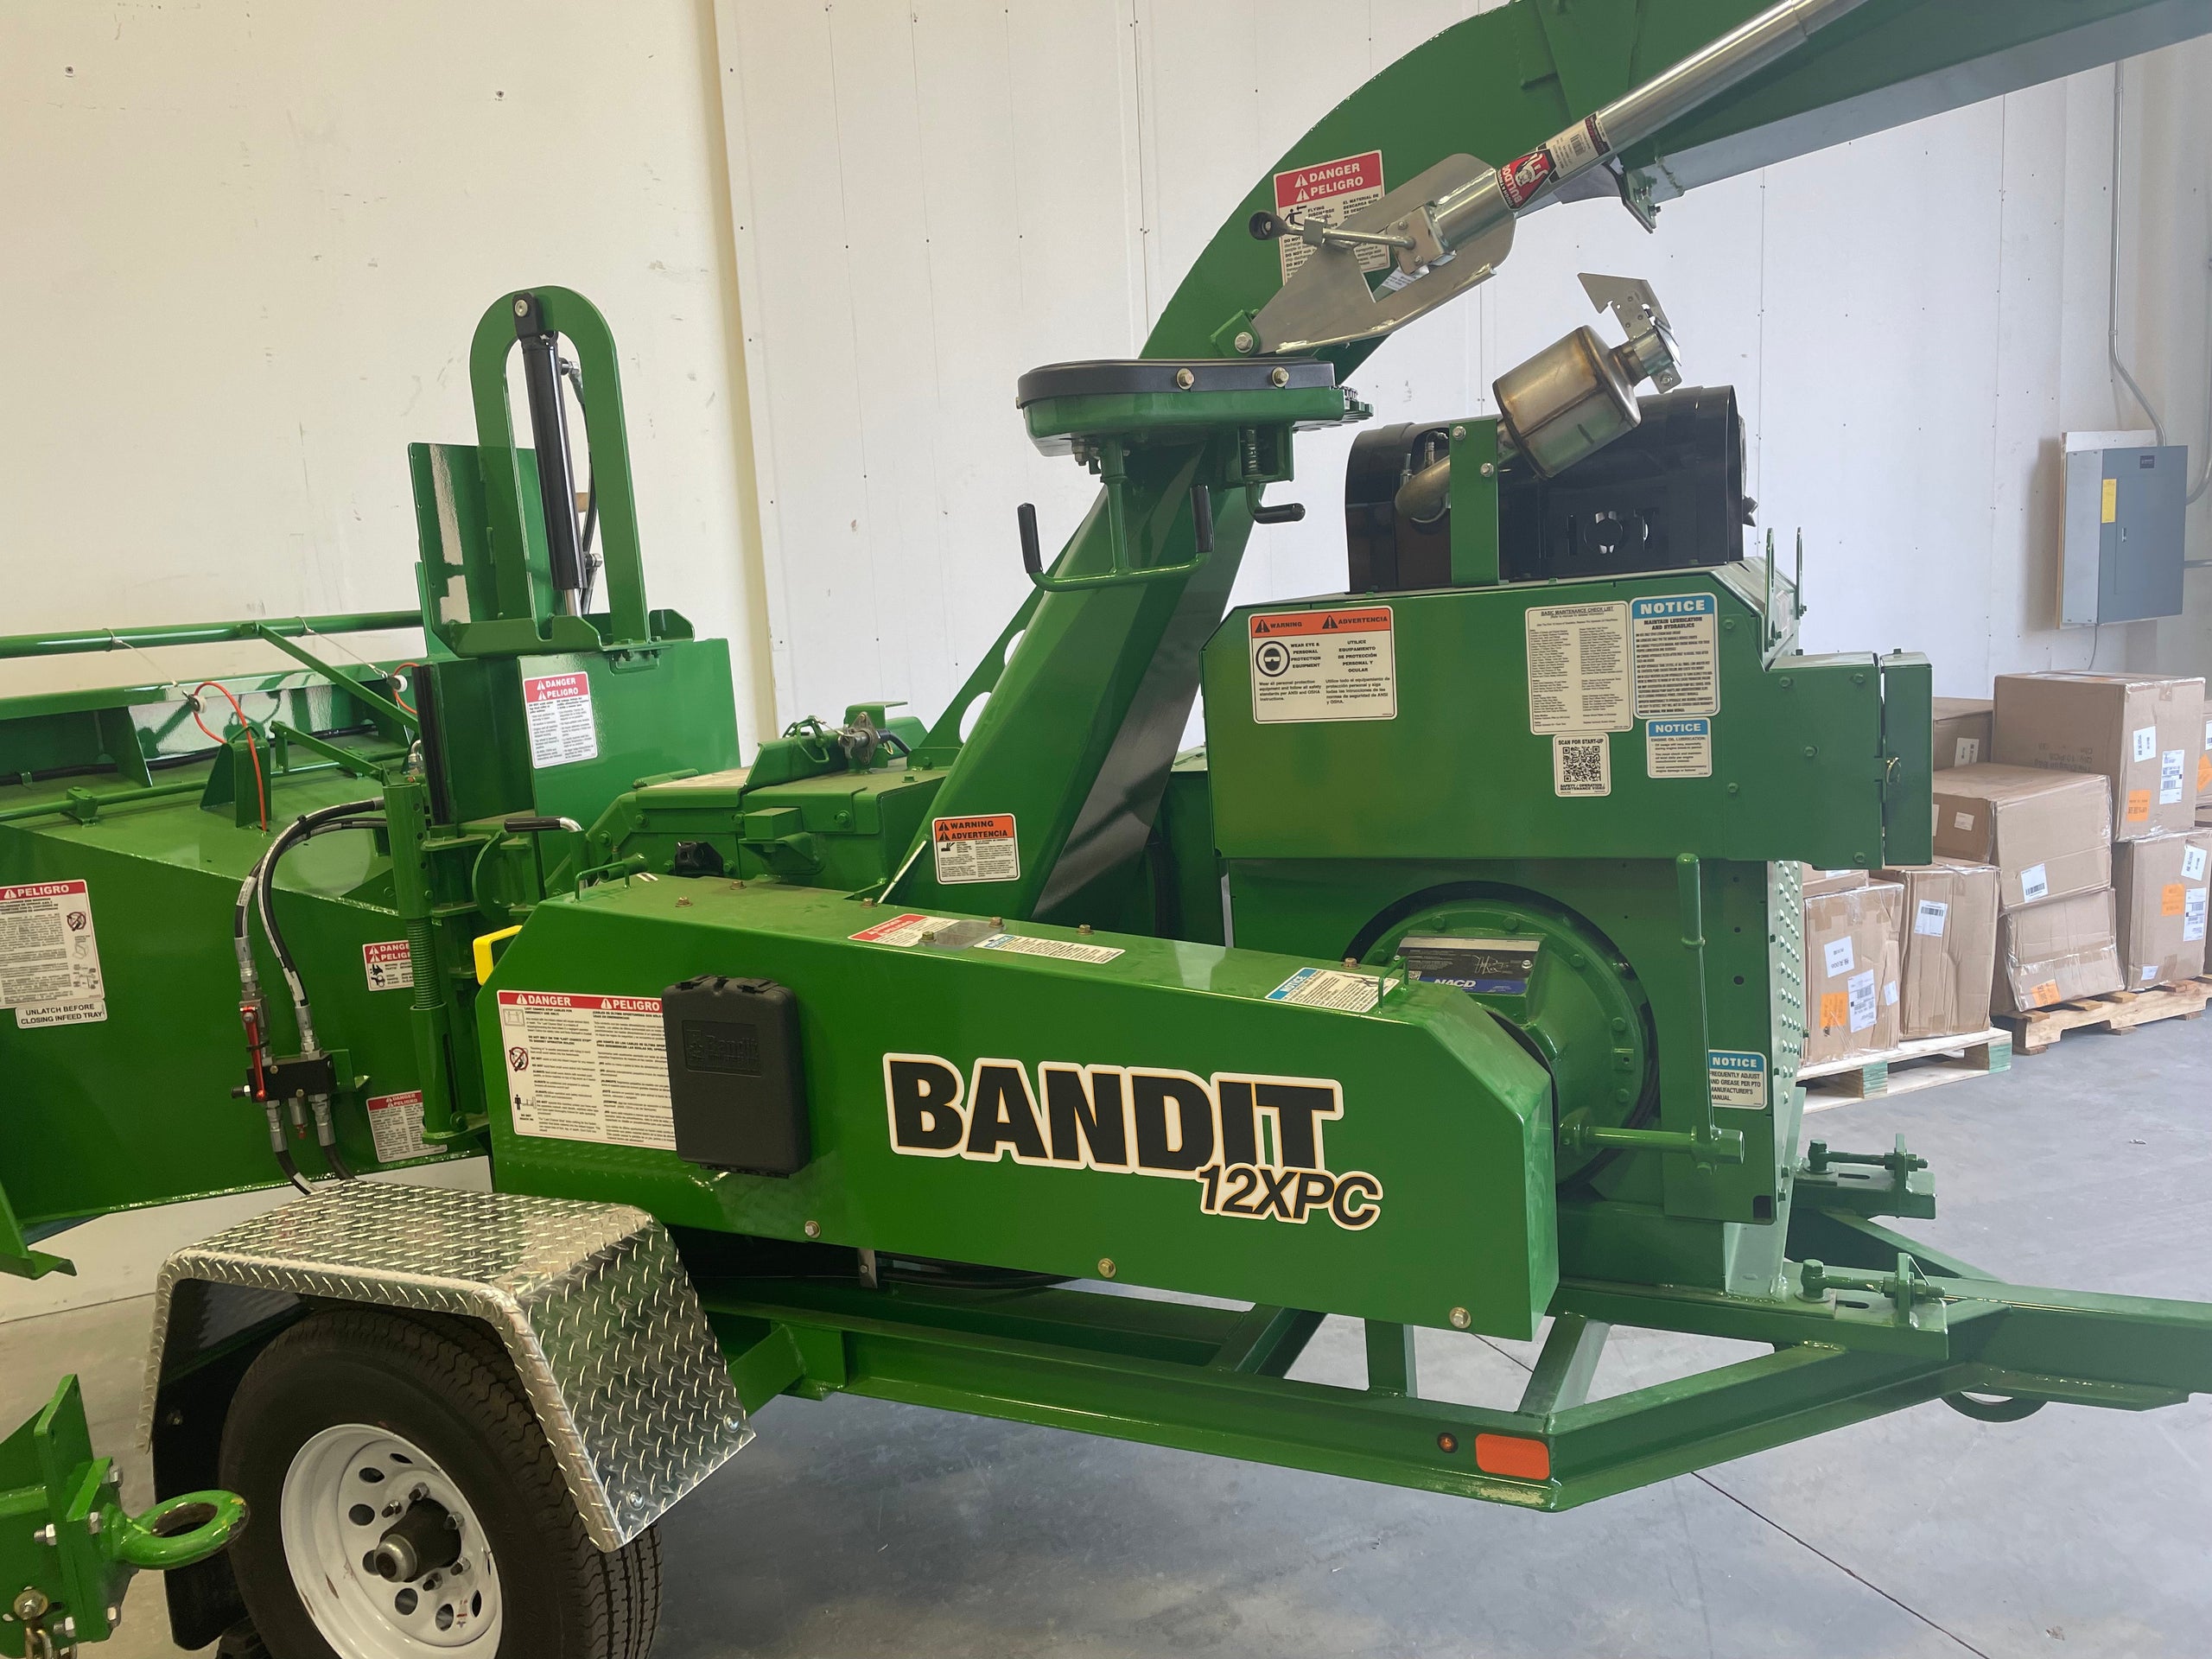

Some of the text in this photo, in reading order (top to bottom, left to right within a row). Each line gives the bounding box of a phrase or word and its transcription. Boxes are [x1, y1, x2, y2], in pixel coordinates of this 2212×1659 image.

[1309, 162, 1361, 183] DANGER
[1311, 176, 1363, 197] PELIGRO
[1640, 599, 1705, 615] NOTICE
[1338, 616, 1388, 625] ADVERTENCIA
[545, 677, 576, 688] DANGER
[547, 688, 579, 698] PELIGRO
[1656, 723, 1701, 733] NOTICE
[950, 820, 994, 830] WARNING
[951, 830, 1007, 840] ADVERTENCIA
[17, 884, 69, 897] PELIGRO
[380, 944, 410, 952] DANGE
[381, 952, 410, 961] PELIG
[1280, 976, 1307, 992] NOTICE
[528, 995, 571, 1006] DANGER
[613, 999, 660, 1011] PELIGRO
[25, 1003, 94, 1015] UNLATCH BEFORE
[21, 1015, 54, 1025] CLOSING
[54, 1013, 82, 1021] INFEED
[1712, 1057, 1758, 1068] NOTICE
[883, 1052, 1344, 1179] BANDIT
[1196, 1162, 1382, 1230] 12XPC
